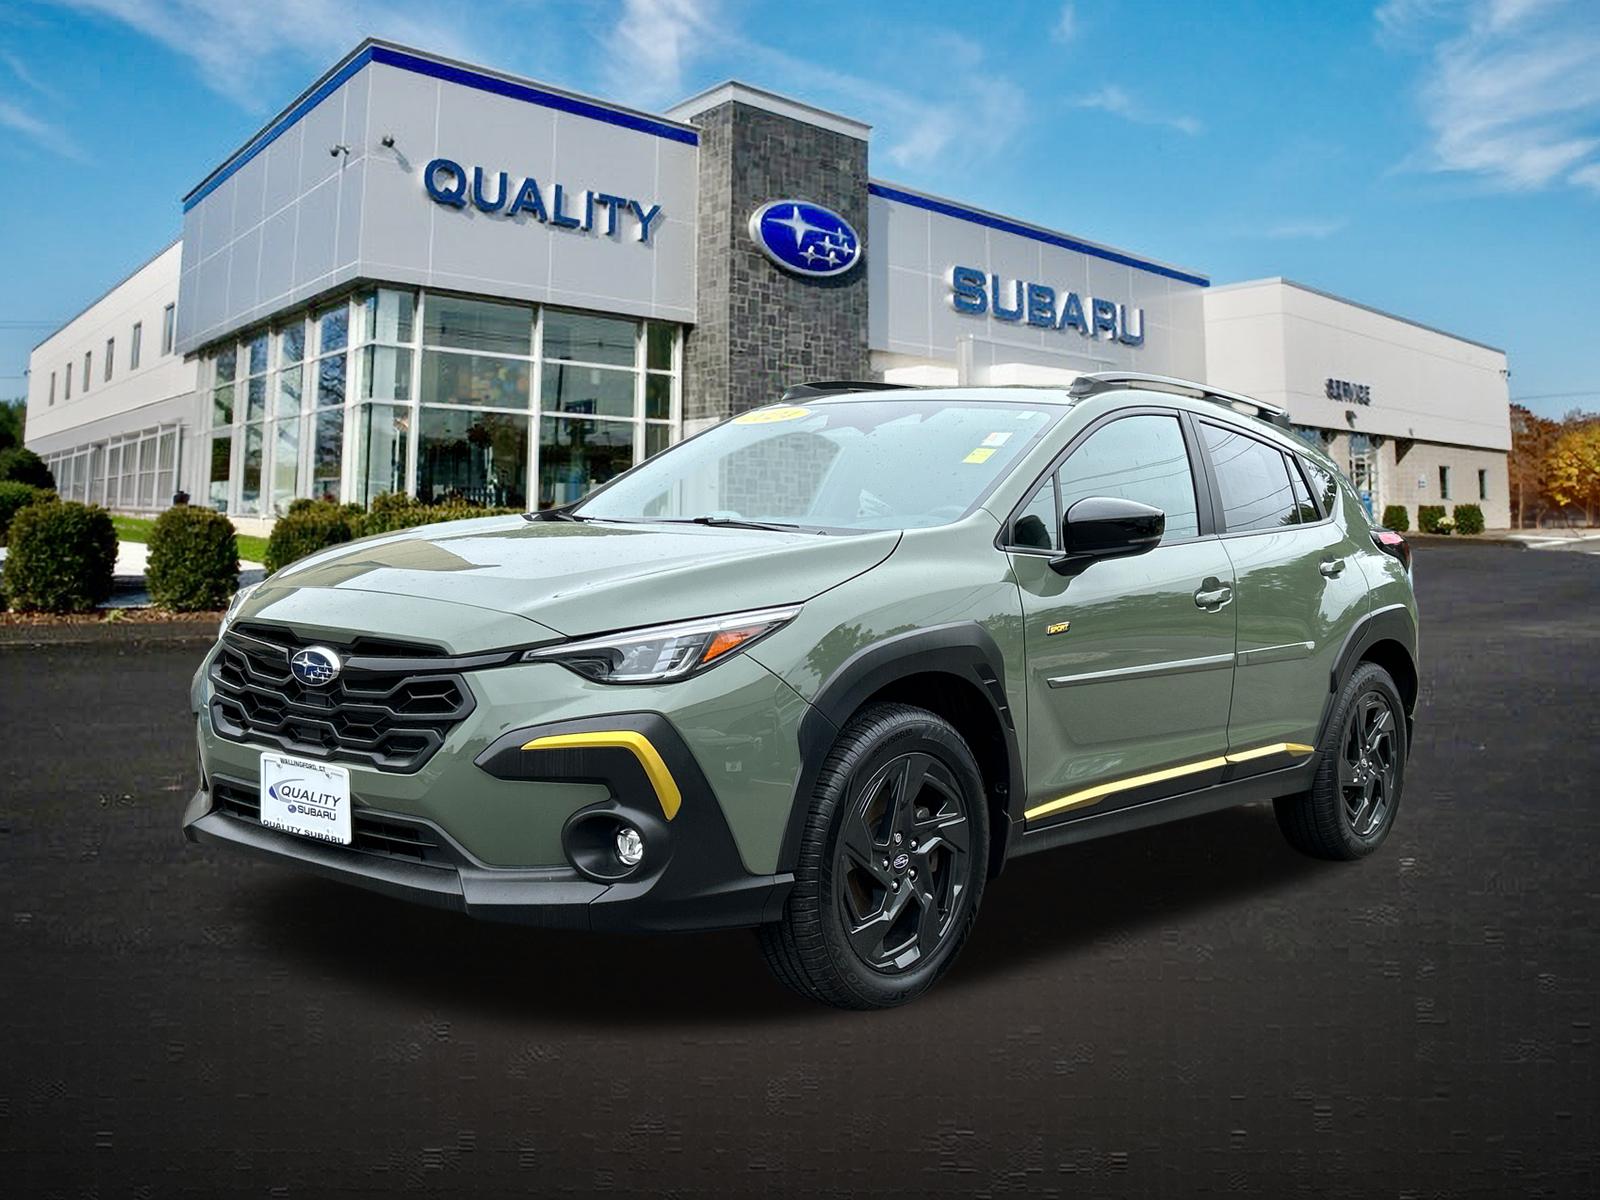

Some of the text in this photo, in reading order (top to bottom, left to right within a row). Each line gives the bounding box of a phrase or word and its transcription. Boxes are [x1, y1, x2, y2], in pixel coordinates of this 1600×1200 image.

[423, 158, 662, 243] QUALITY
[951, 265, 1145, 347] SUBARU
[1325, 378, 1371, 406] SERVICE
[281, 786, 341, 807] QUALITY
[297, 805, 337, 821] SUBARU
[263, 819, 344, 843] QUALITY SUBARU
